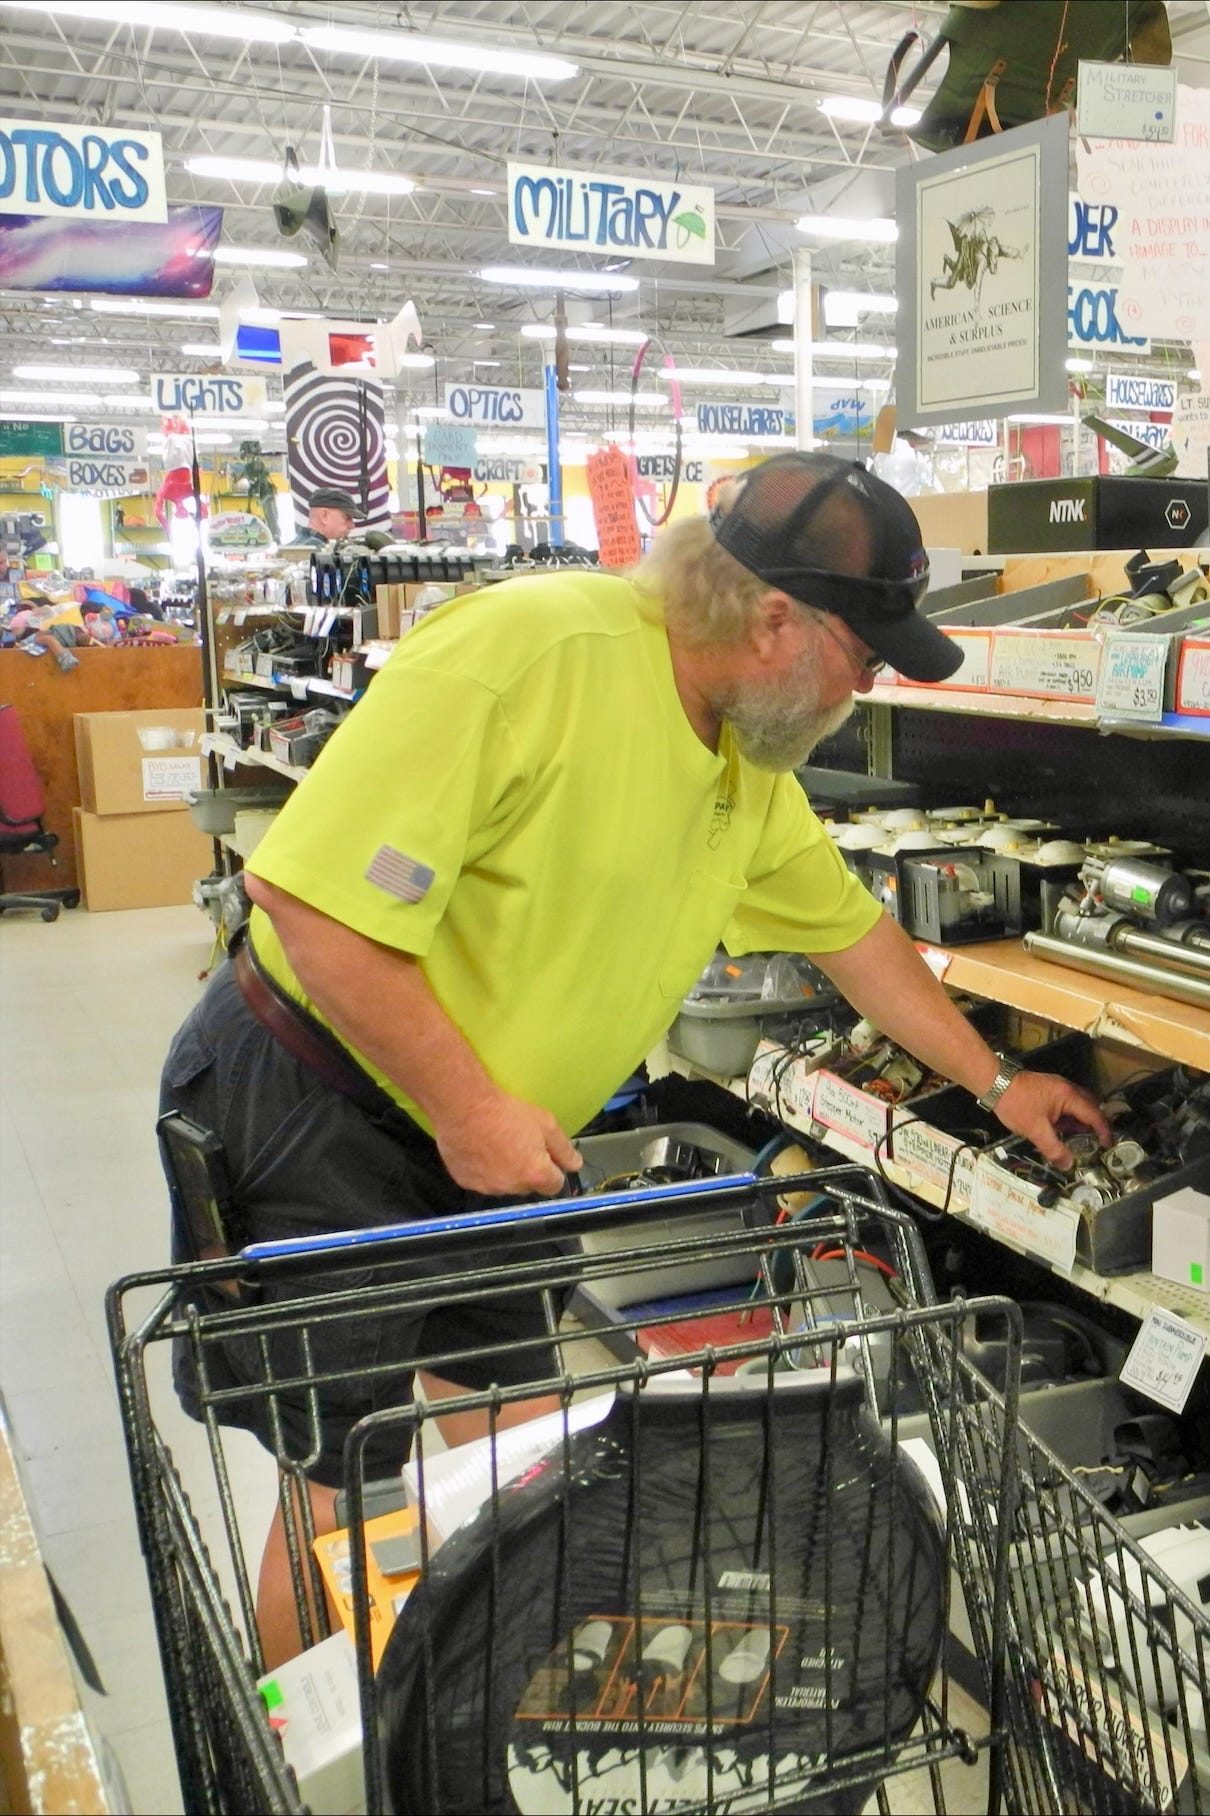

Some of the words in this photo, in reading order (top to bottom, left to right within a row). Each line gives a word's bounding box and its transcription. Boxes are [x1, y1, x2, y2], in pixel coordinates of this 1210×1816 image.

[1087, 68, 1147, 86] MILITARY
[1103, 84, 1172, 105] STRETCHER
[1132, 219, 1141, 236] A
[1149, 217, 1197, 236] DISPLAY
[1129, 243, 1177, 259] HOMAGE
[923, 311, 974, 332] AMERICAN
[988, 298, 1033, 320] SCIENCE
[949, 334, 957, 345] &
[959, 324, 1003, 345] SURPLUS
[69, 462, 127, 487] BOXES
